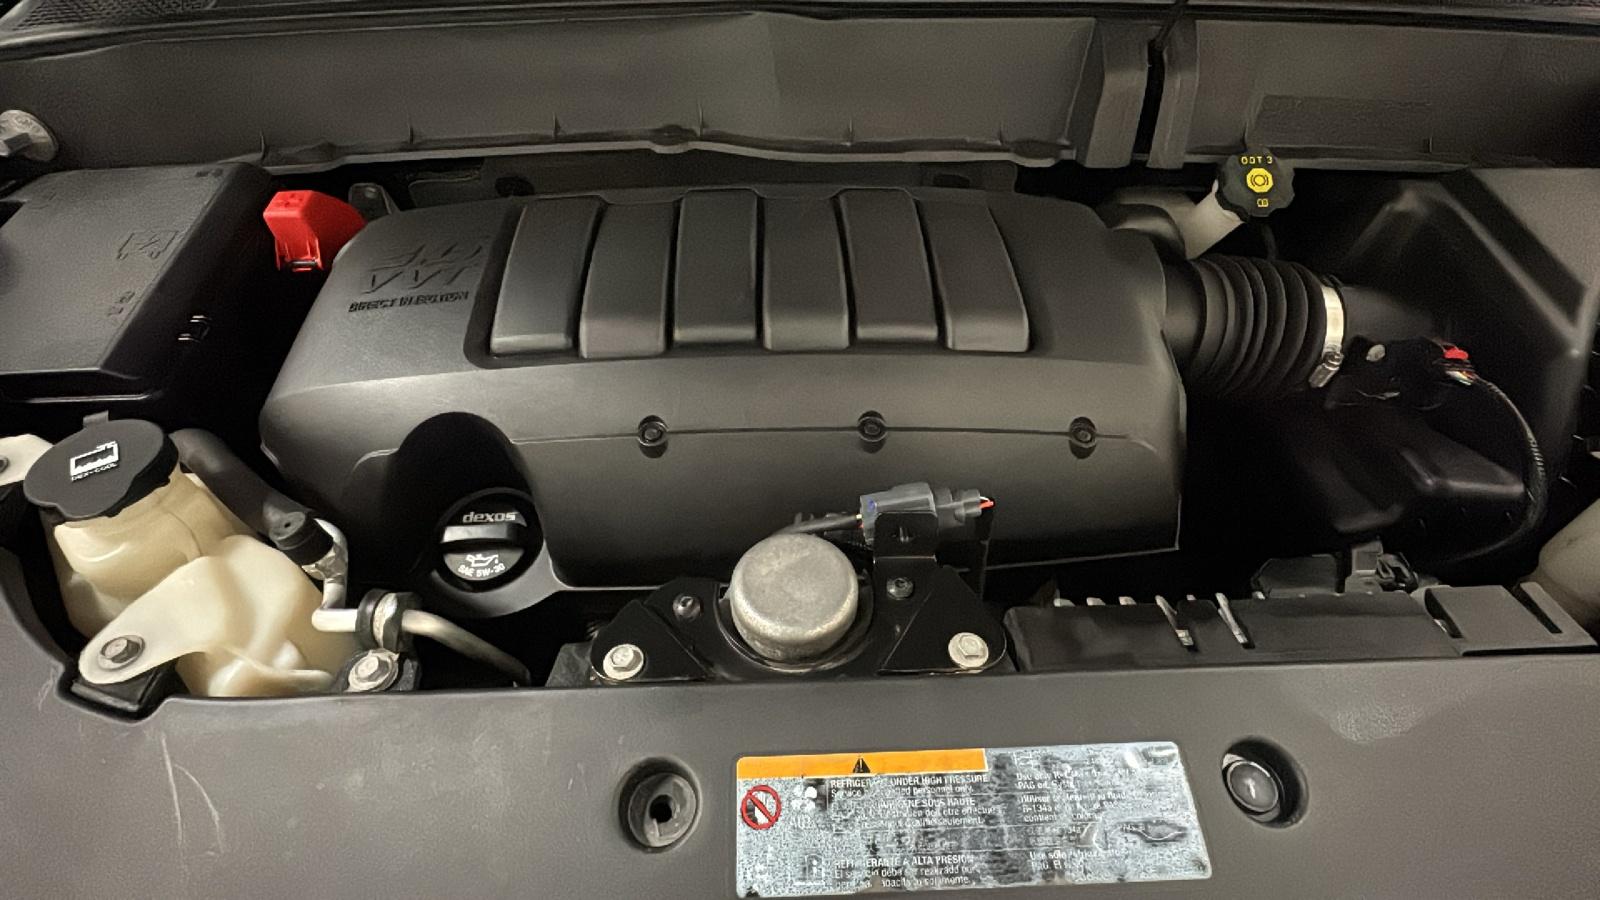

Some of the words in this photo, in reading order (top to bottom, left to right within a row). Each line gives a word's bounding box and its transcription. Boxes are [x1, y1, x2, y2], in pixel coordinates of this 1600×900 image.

[1266, 155, 1273, 164] 3
[462, 511, 517, 523] dexos
[458, 564, 475, 577] SAE
[476, 562, 506, 577] 5W-30
[890, 776, 919, 787] UNDER
